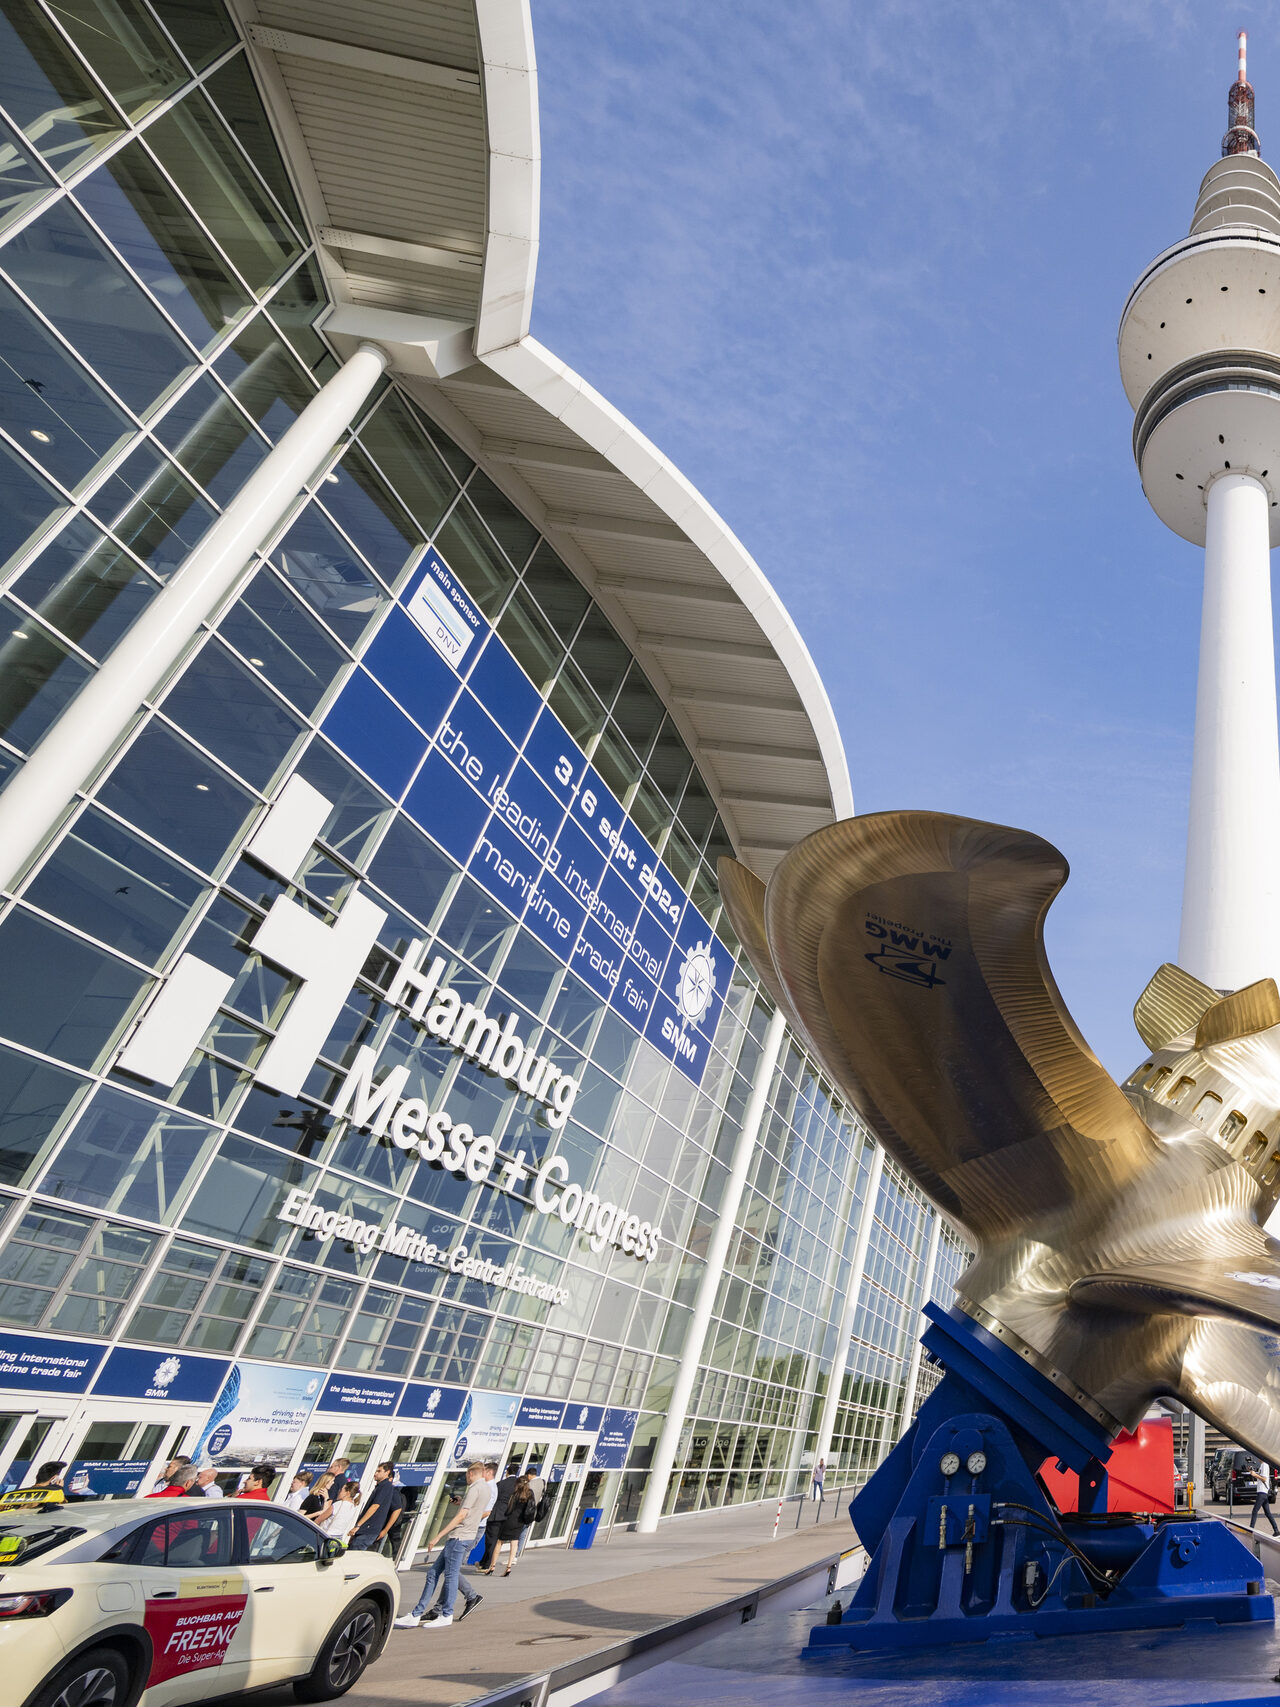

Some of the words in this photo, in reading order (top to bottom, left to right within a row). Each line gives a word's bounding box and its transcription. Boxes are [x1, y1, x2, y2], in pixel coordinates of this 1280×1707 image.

[430, 560, 453, 592] main
[450, 586, 481, 628] sponsor
[436, 626, 459, 655] DNV
[438, 721, 484, 780] the
[487, 774, 562, 872] leading
[565, 860, 662, 979] international
[599, 817, 639, 870] sept
[638, 863, 681, 925] 2024
[477, 836, 571, 938] maritime
[575, 932, 620, 987] trade
[623, 978, 650, 1012] fair
[865, 920, 953, 960] MMG
[384, 938, 582, 1129] Hamburg
[661, 1017, 698, 1063] SMM
[330, 1044, 496, 1183] Messe
[503, 1150, 527, 1192] +
[534, 1155, 662, 1263] Congress
[278, 1188, 380, 1253] Eingang
[382, 1222, 438, 1266] Mitte
[448, 1245, 512, 1287] Central
[509, 1266, 569, 1305] Entrance
[20, 1352, 89, 1368] international
[31, 1366, 61, 1377] trade
[62, 1369, 82, 1378] fair
[145, 1388, 169, 1397] SMM
[330, 1385, 341, 1393] the
[361, 1389, 395, 1398] international
[271, 1417, 303, 1426] transition
[272, 1409, 294, 1418] driving
[12, 1491, 44, 1502] TAXI
[176, 1612, 223, 1626] BUCHBAR
[224, 1610, 244, 1619] AUF
[177, 1655, 192, 1665] Die
